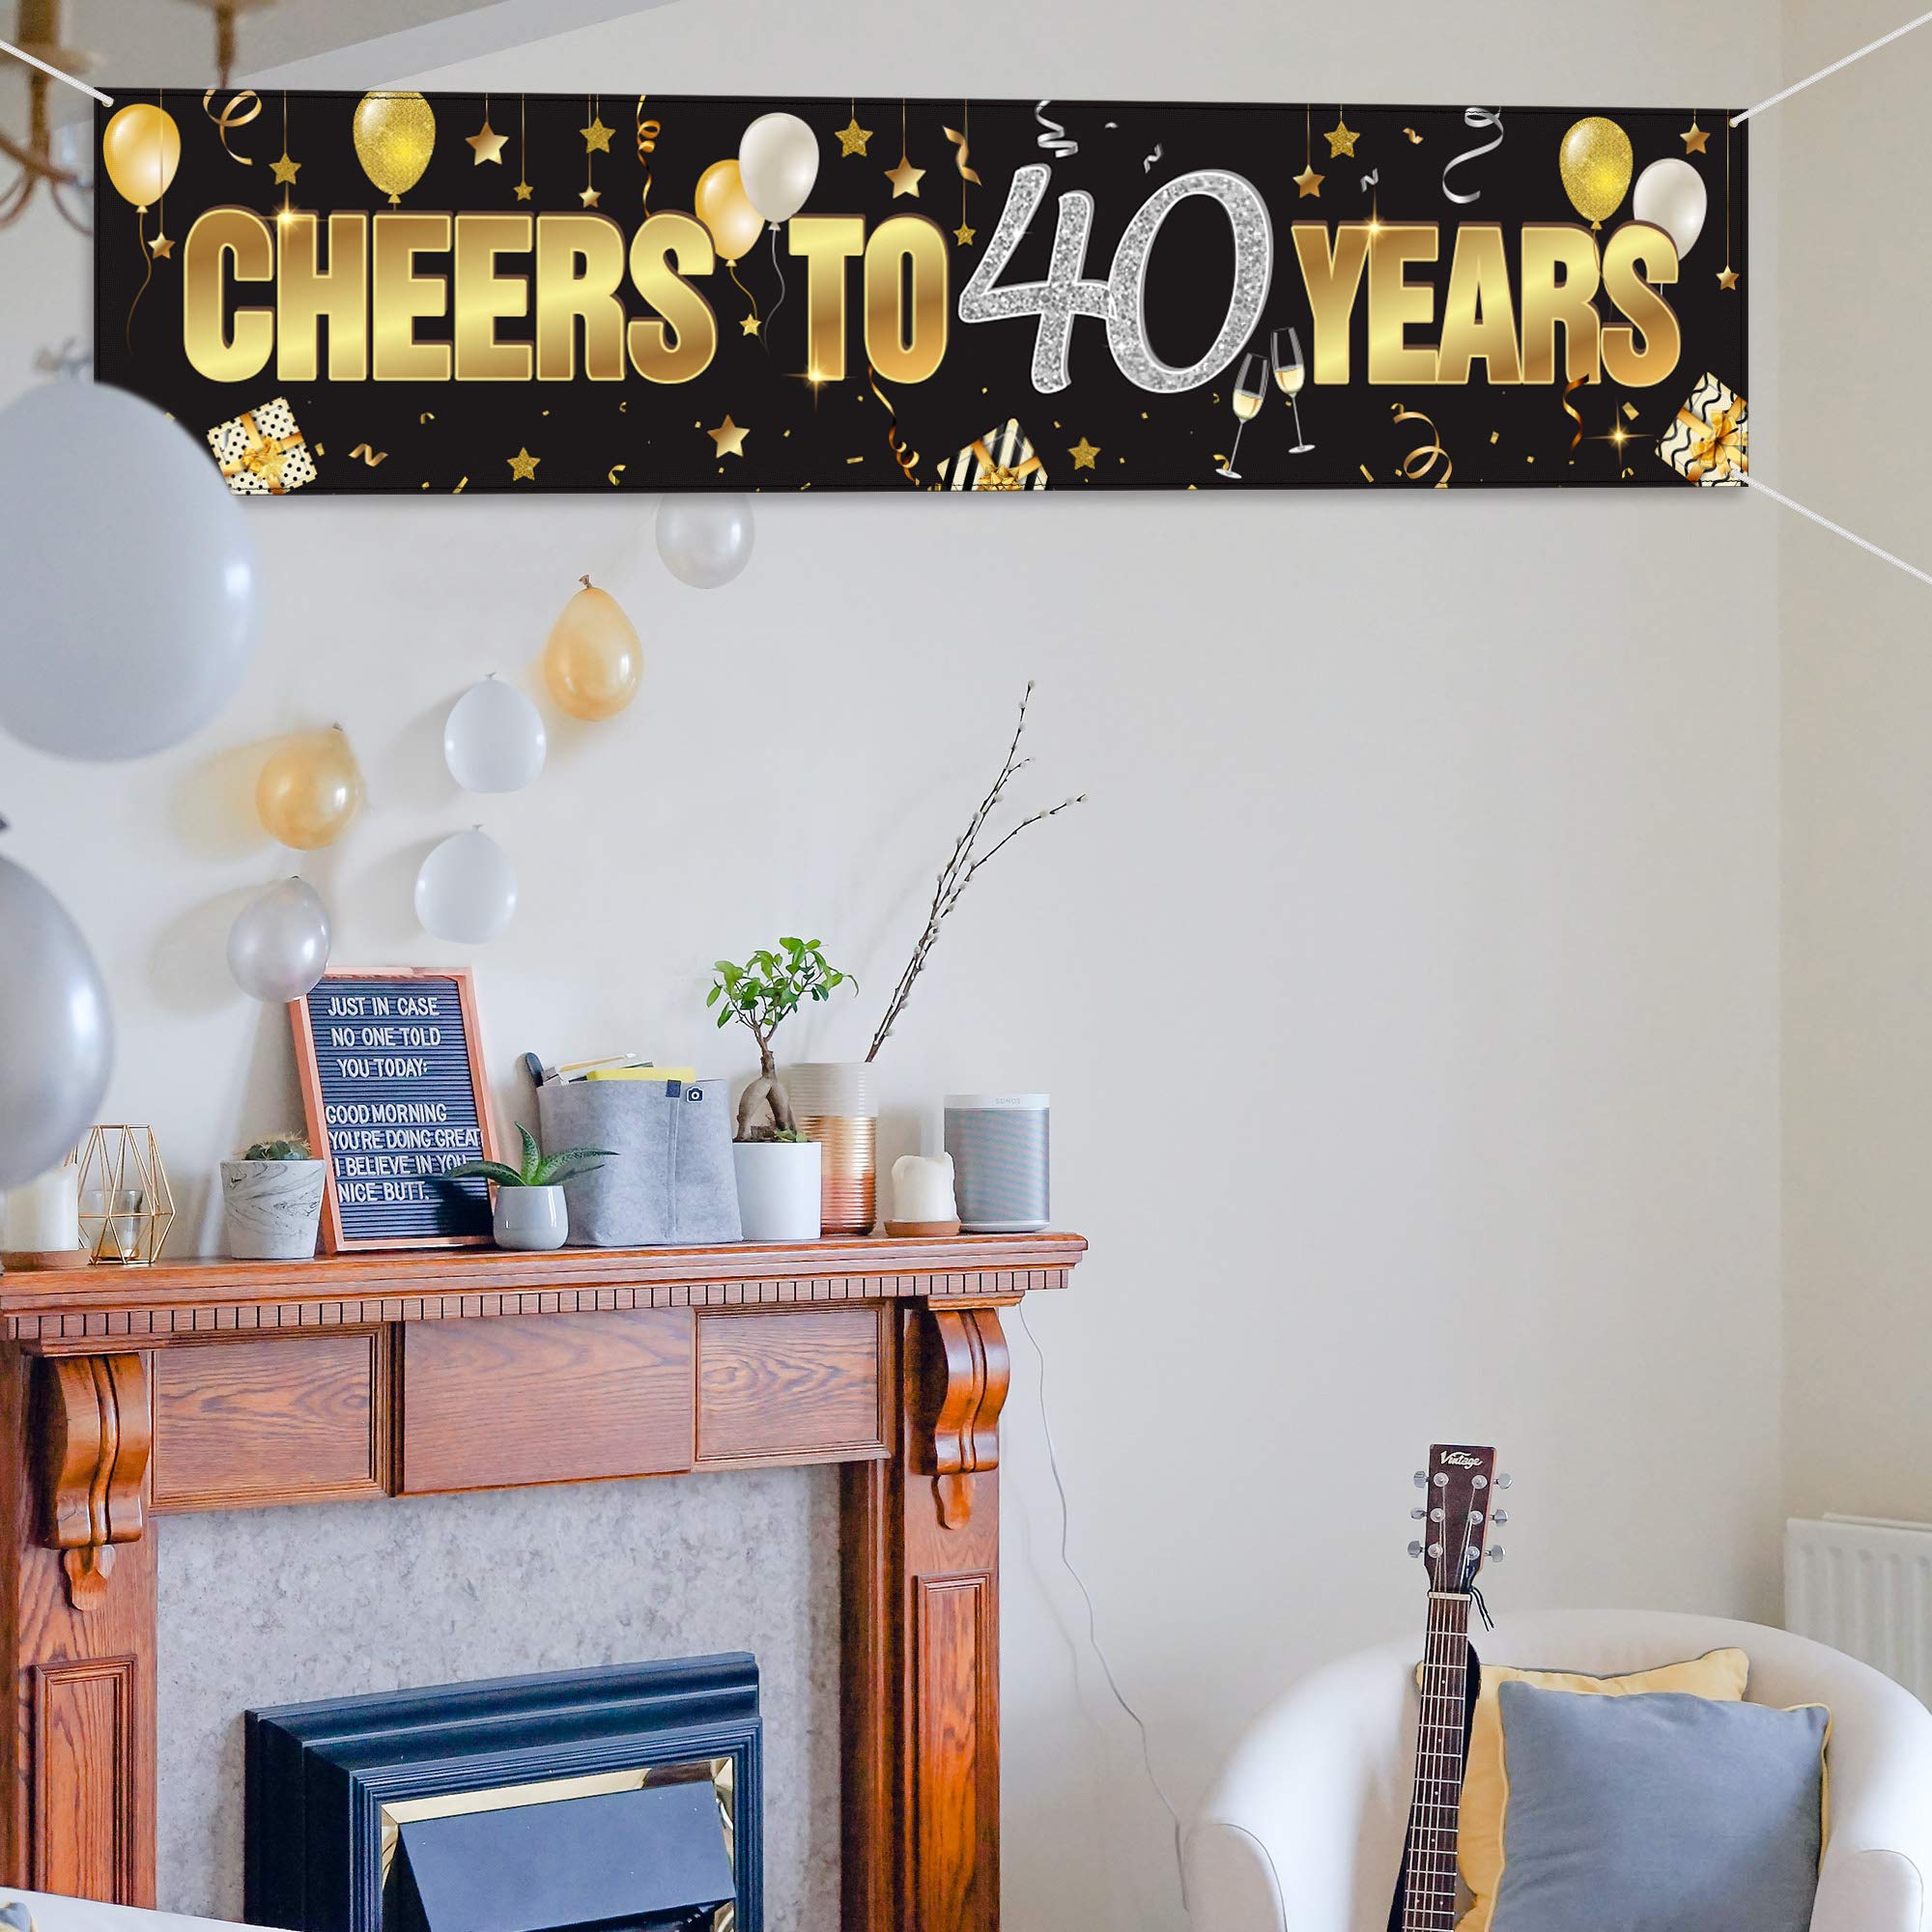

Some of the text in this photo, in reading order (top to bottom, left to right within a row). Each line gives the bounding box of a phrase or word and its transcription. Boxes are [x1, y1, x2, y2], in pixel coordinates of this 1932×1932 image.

[183, 162, 1682, 394] CHEERS TO 40 YEARS
[327, 996, 440, 1017] JUST IN CASE
[330, 1027, 441, 1048] NO ONE TOLD
[337, 1057, 429, 1078] YOU TODAY:
[325, 1103, 447, 1125] GOOD MORNING
[328, 1129, 384, 1151] YOU'RE
[385, 1128, 433, 1149] DOING
[334, 1157, 341, 1178] I
[345, 1155, 412, 1178] BELIEVE
[415, 1155, 434, 1175] IN
[337, 1180, 431, 1203] NICE BUTT.
[1440, 1451, 1483, 1469] Vintage
